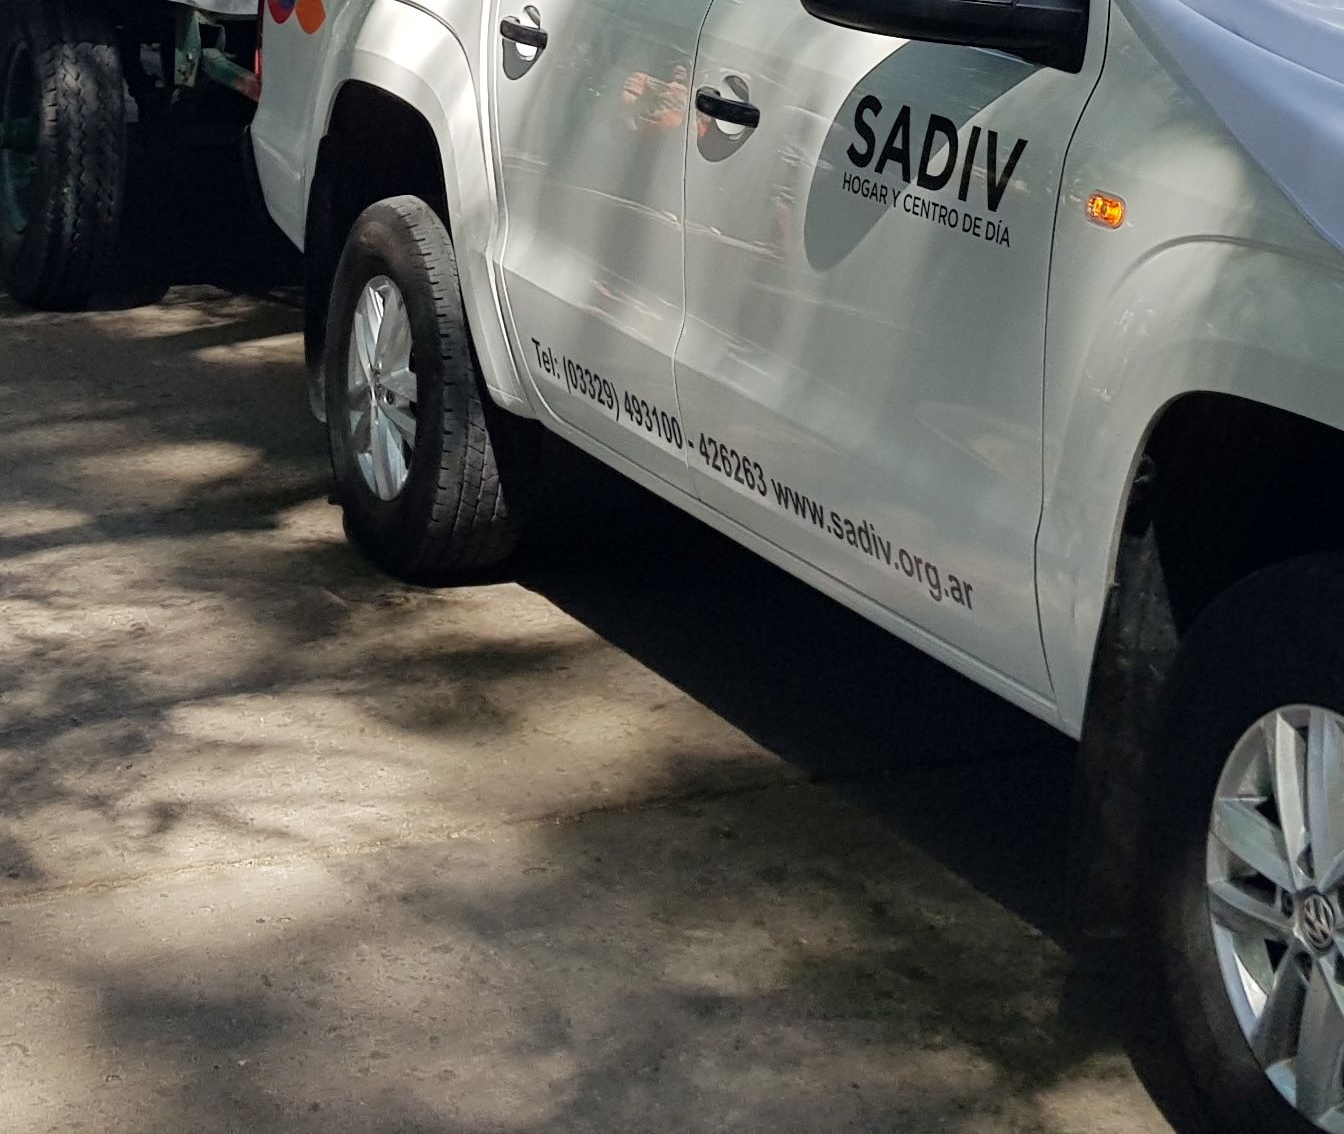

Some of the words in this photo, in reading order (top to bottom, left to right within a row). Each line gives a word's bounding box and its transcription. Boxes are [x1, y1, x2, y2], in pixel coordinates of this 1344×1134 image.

[842, 172, 888, 205] HOGAR
[892, 188, 902, 208] Y
[903, 194, 958, 228] CENTRO
[962, 213, 982, 237] DE
[985, 219, 1010, 248] DÍA
[846, 94, 1029, 213] SADIV
[531, 337, 560, 379] Tel:
[563, 356, 620, 421] (03329)
[624, 391, 683, 450] 493100
[699, 432, 767, 497] 426263
[770, 478, 974, 610] www.sadiv.org.ar
